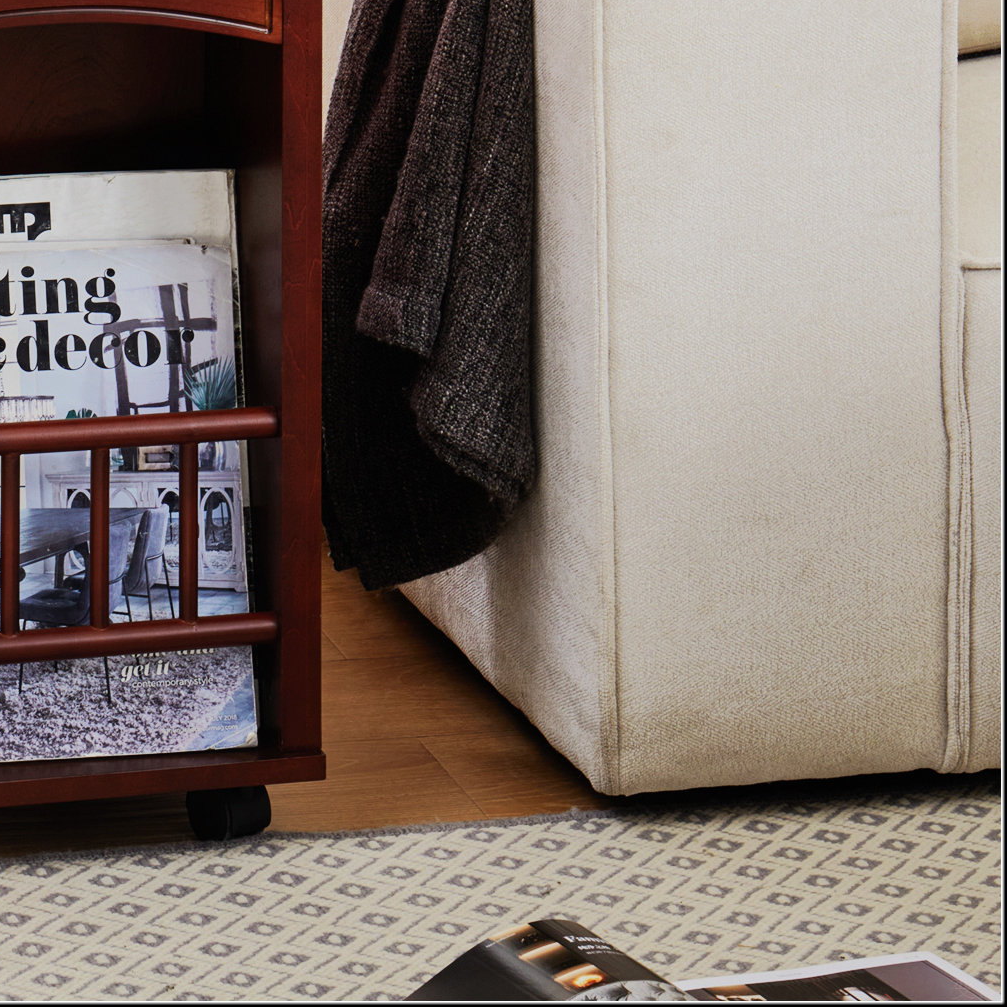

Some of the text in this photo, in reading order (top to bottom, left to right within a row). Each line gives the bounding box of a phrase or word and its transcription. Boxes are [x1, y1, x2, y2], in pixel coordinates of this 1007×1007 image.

[16, 319, 195, 372] decor
[121, 660, 170, 682] get it
[132, 676, 214, 688] contemporary style
